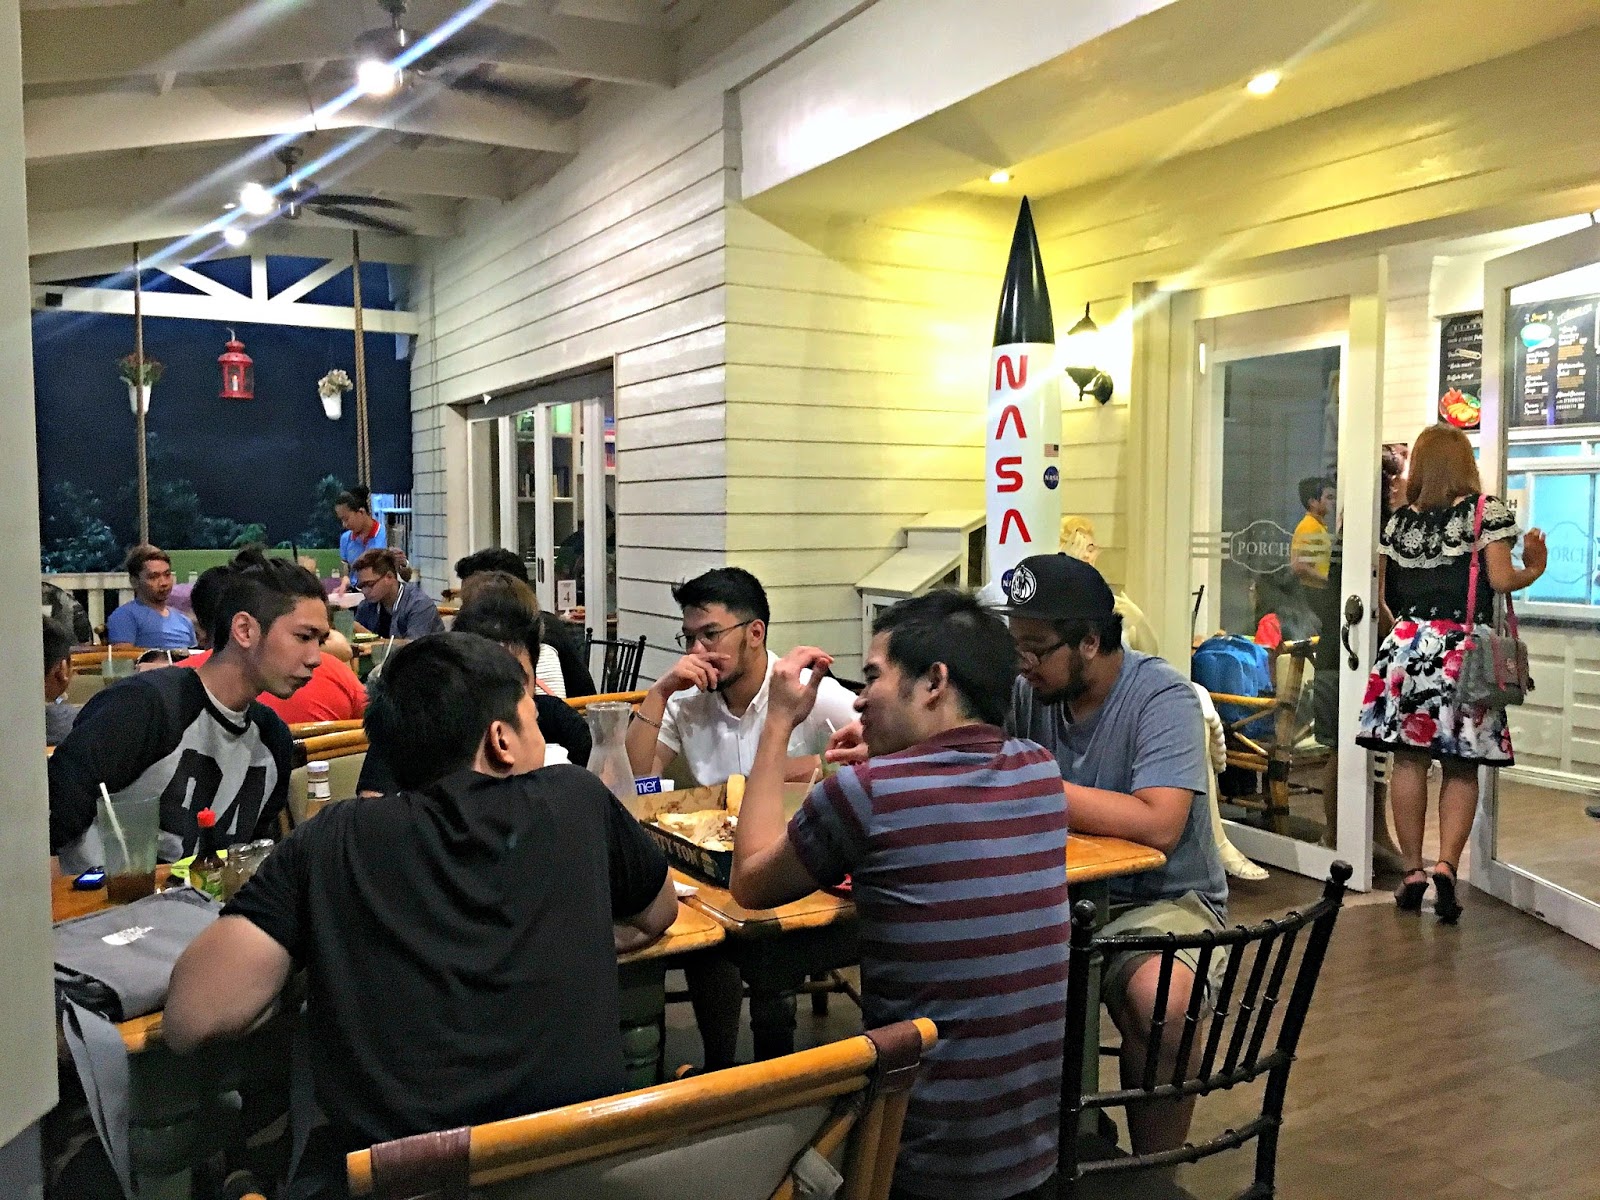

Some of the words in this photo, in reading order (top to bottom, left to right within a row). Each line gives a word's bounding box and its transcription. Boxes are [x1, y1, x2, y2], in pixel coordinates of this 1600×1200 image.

[995, 354, 1032, 545] NASA
[1237, 541, 1290, 557] PORCH
[563, 591, 571, 603] 4
